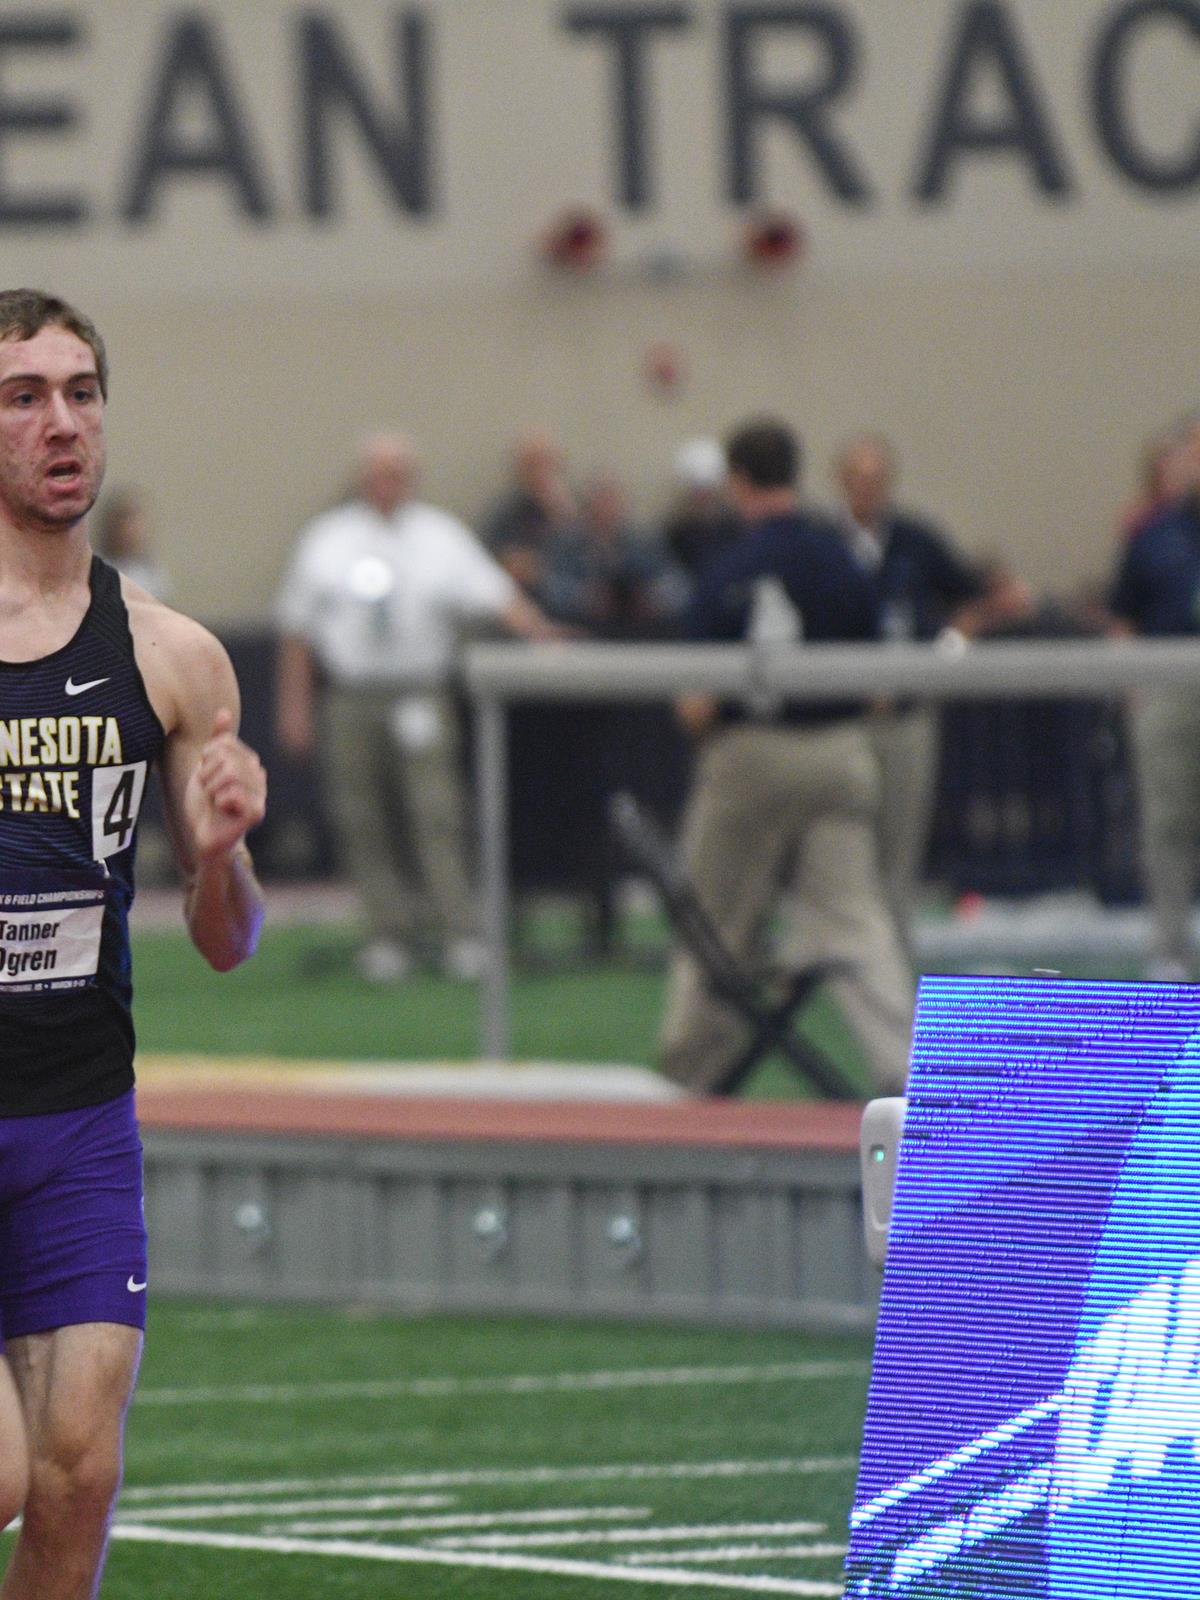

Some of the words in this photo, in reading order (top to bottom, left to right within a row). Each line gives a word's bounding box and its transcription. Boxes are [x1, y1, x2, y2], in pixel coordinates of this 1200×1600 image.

[558, 0, 1200, 212] TRAC
[102, 769, 136, 849] 4
[13, 893, 37, 905] FIELD
